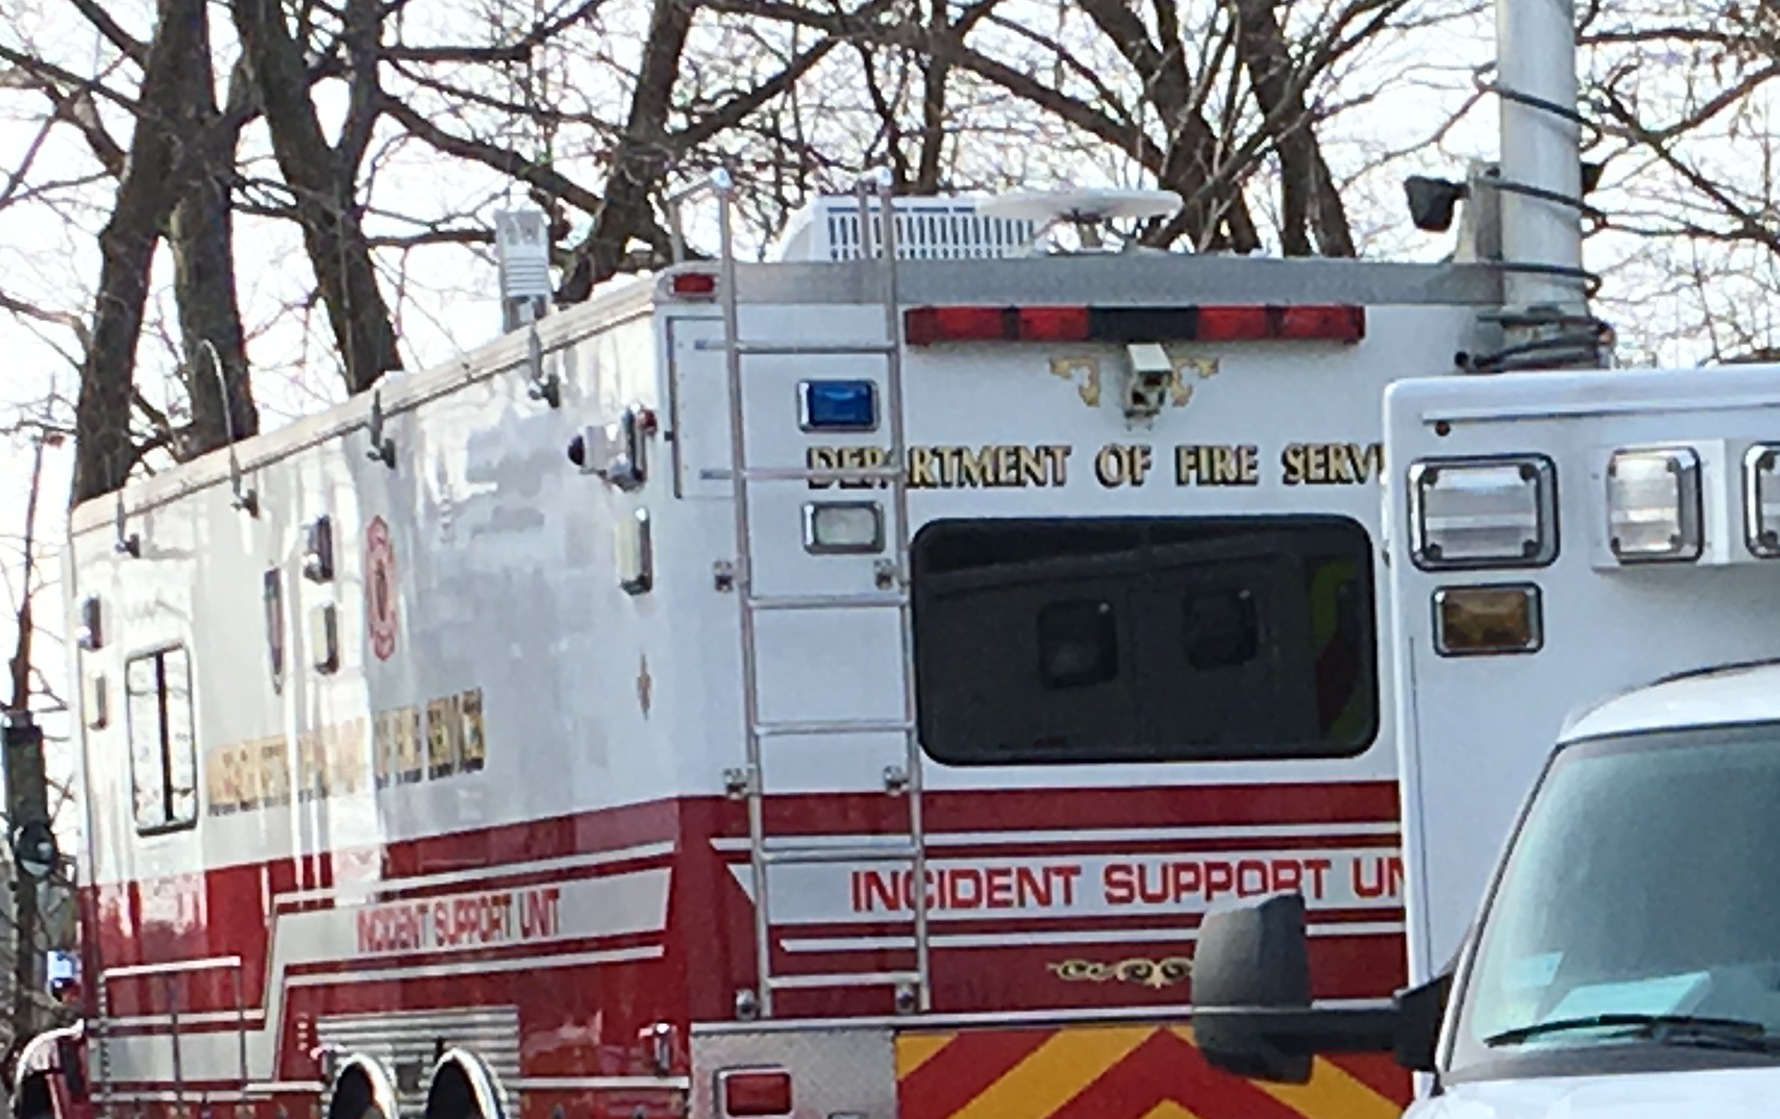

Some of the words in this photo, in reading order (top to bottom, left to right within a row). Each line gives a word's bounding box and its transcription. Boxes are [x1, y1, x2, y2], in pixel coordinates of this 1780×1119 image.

[1094, 443, 1151, 488] OF
[1175, 445, 1259, 486] FIRE
[852, 865, 1082, 912] INCIDENT
[1104, 859, 1332, 905] SUPPORT
[434, 894, 512, 947] SUPPORT
[517, 888, 560, 939] UNIT
